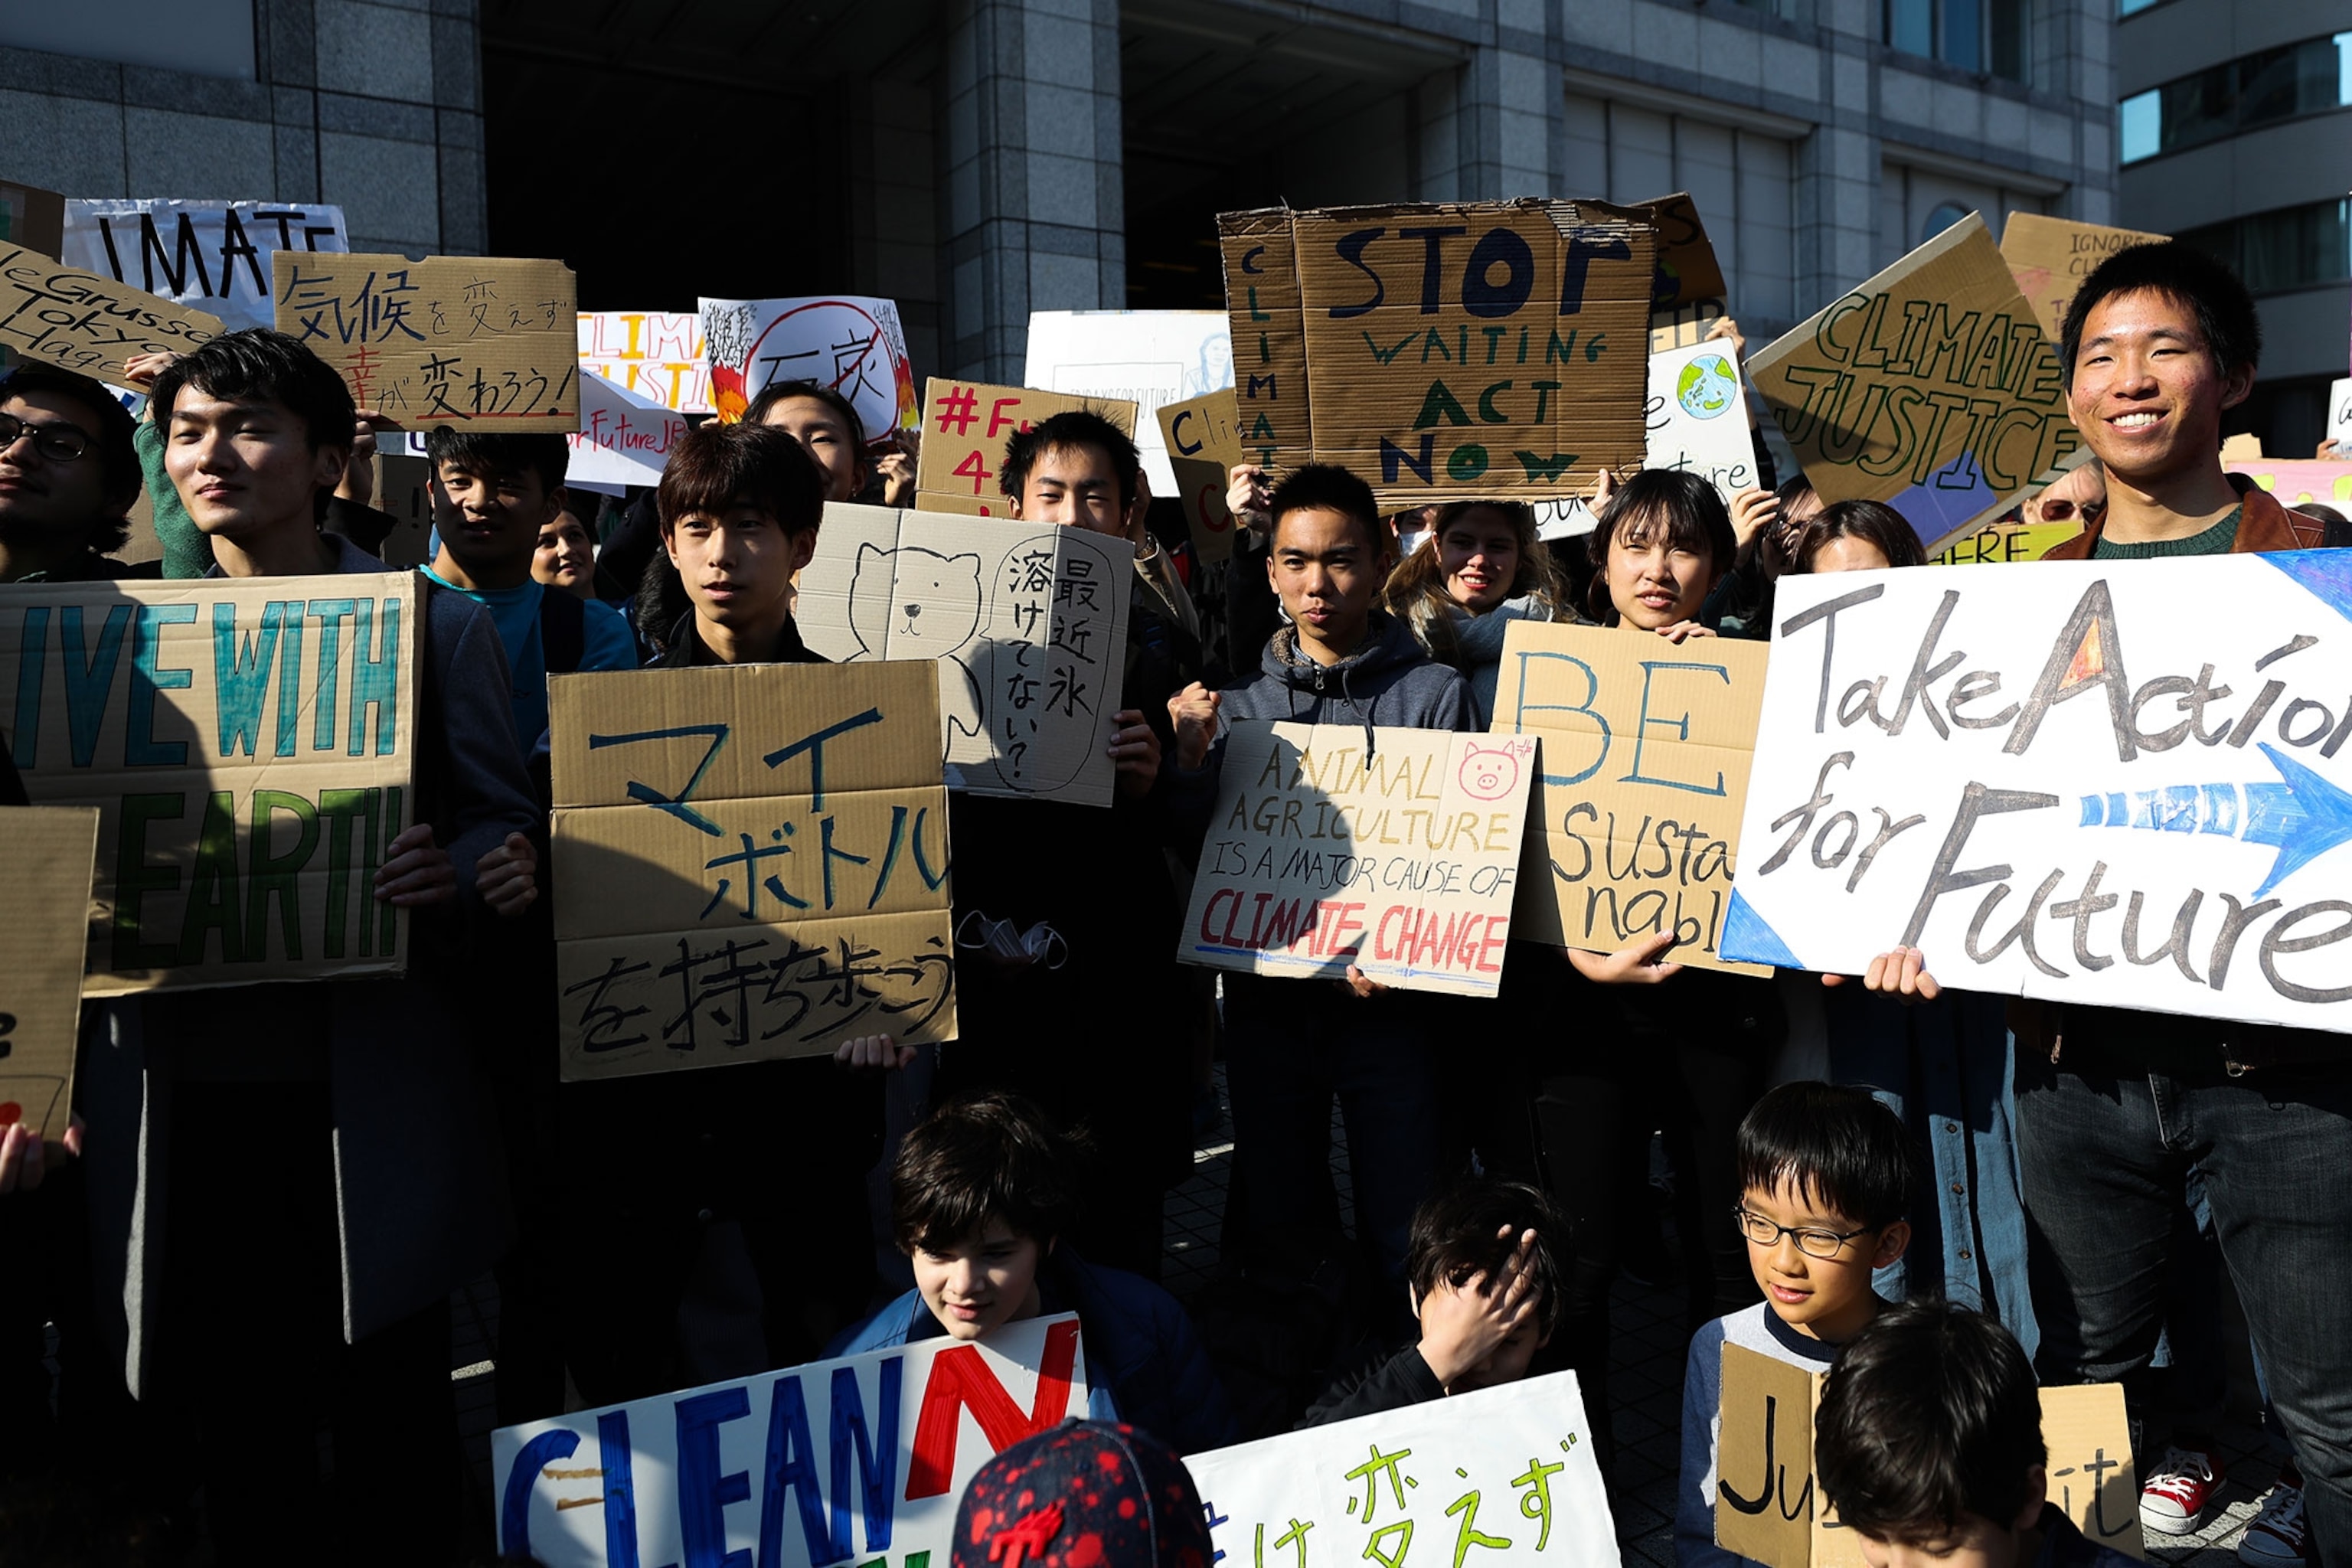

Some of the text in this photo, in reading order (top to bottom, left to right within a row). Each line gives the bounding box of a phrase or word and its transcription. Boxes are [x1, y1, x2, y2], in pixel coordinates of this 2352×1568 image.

[12, 283, 175, 355] Tokyo
[279, 265, 568, 345] 気候を変えず
[1361, 325, 1607, 367] WAITING
[1816, 293, 2065, 404] CLIMATE
[1380, 433, 1580, 485] NOW
[1412, 378, 1562, 432] ACT
[1775, 365, 2079, 491] JUSTICE
[213, 597, 401, 763] WITH
[1045, 558, 1101, 718] 最近氷
[1780, 583, 2020, 741] Take
[589, 706, 884, 838] マイ
[1257, 743, 1440, 801] ANIMAL
[1515, 652, 1730, 796] BE
[700, 805, 953, 920] ボトル
[1210, 841, 1516, 898] IS A MAJOR CAUSE OF
[1228, 792, 1511, 852] AGRICULTURE
[1758, 751, 2352, 1004] for Future
[111, 786, 403, 971] EARTH
[1200, 888, 1509, 973] CLIMATE CHANGE
